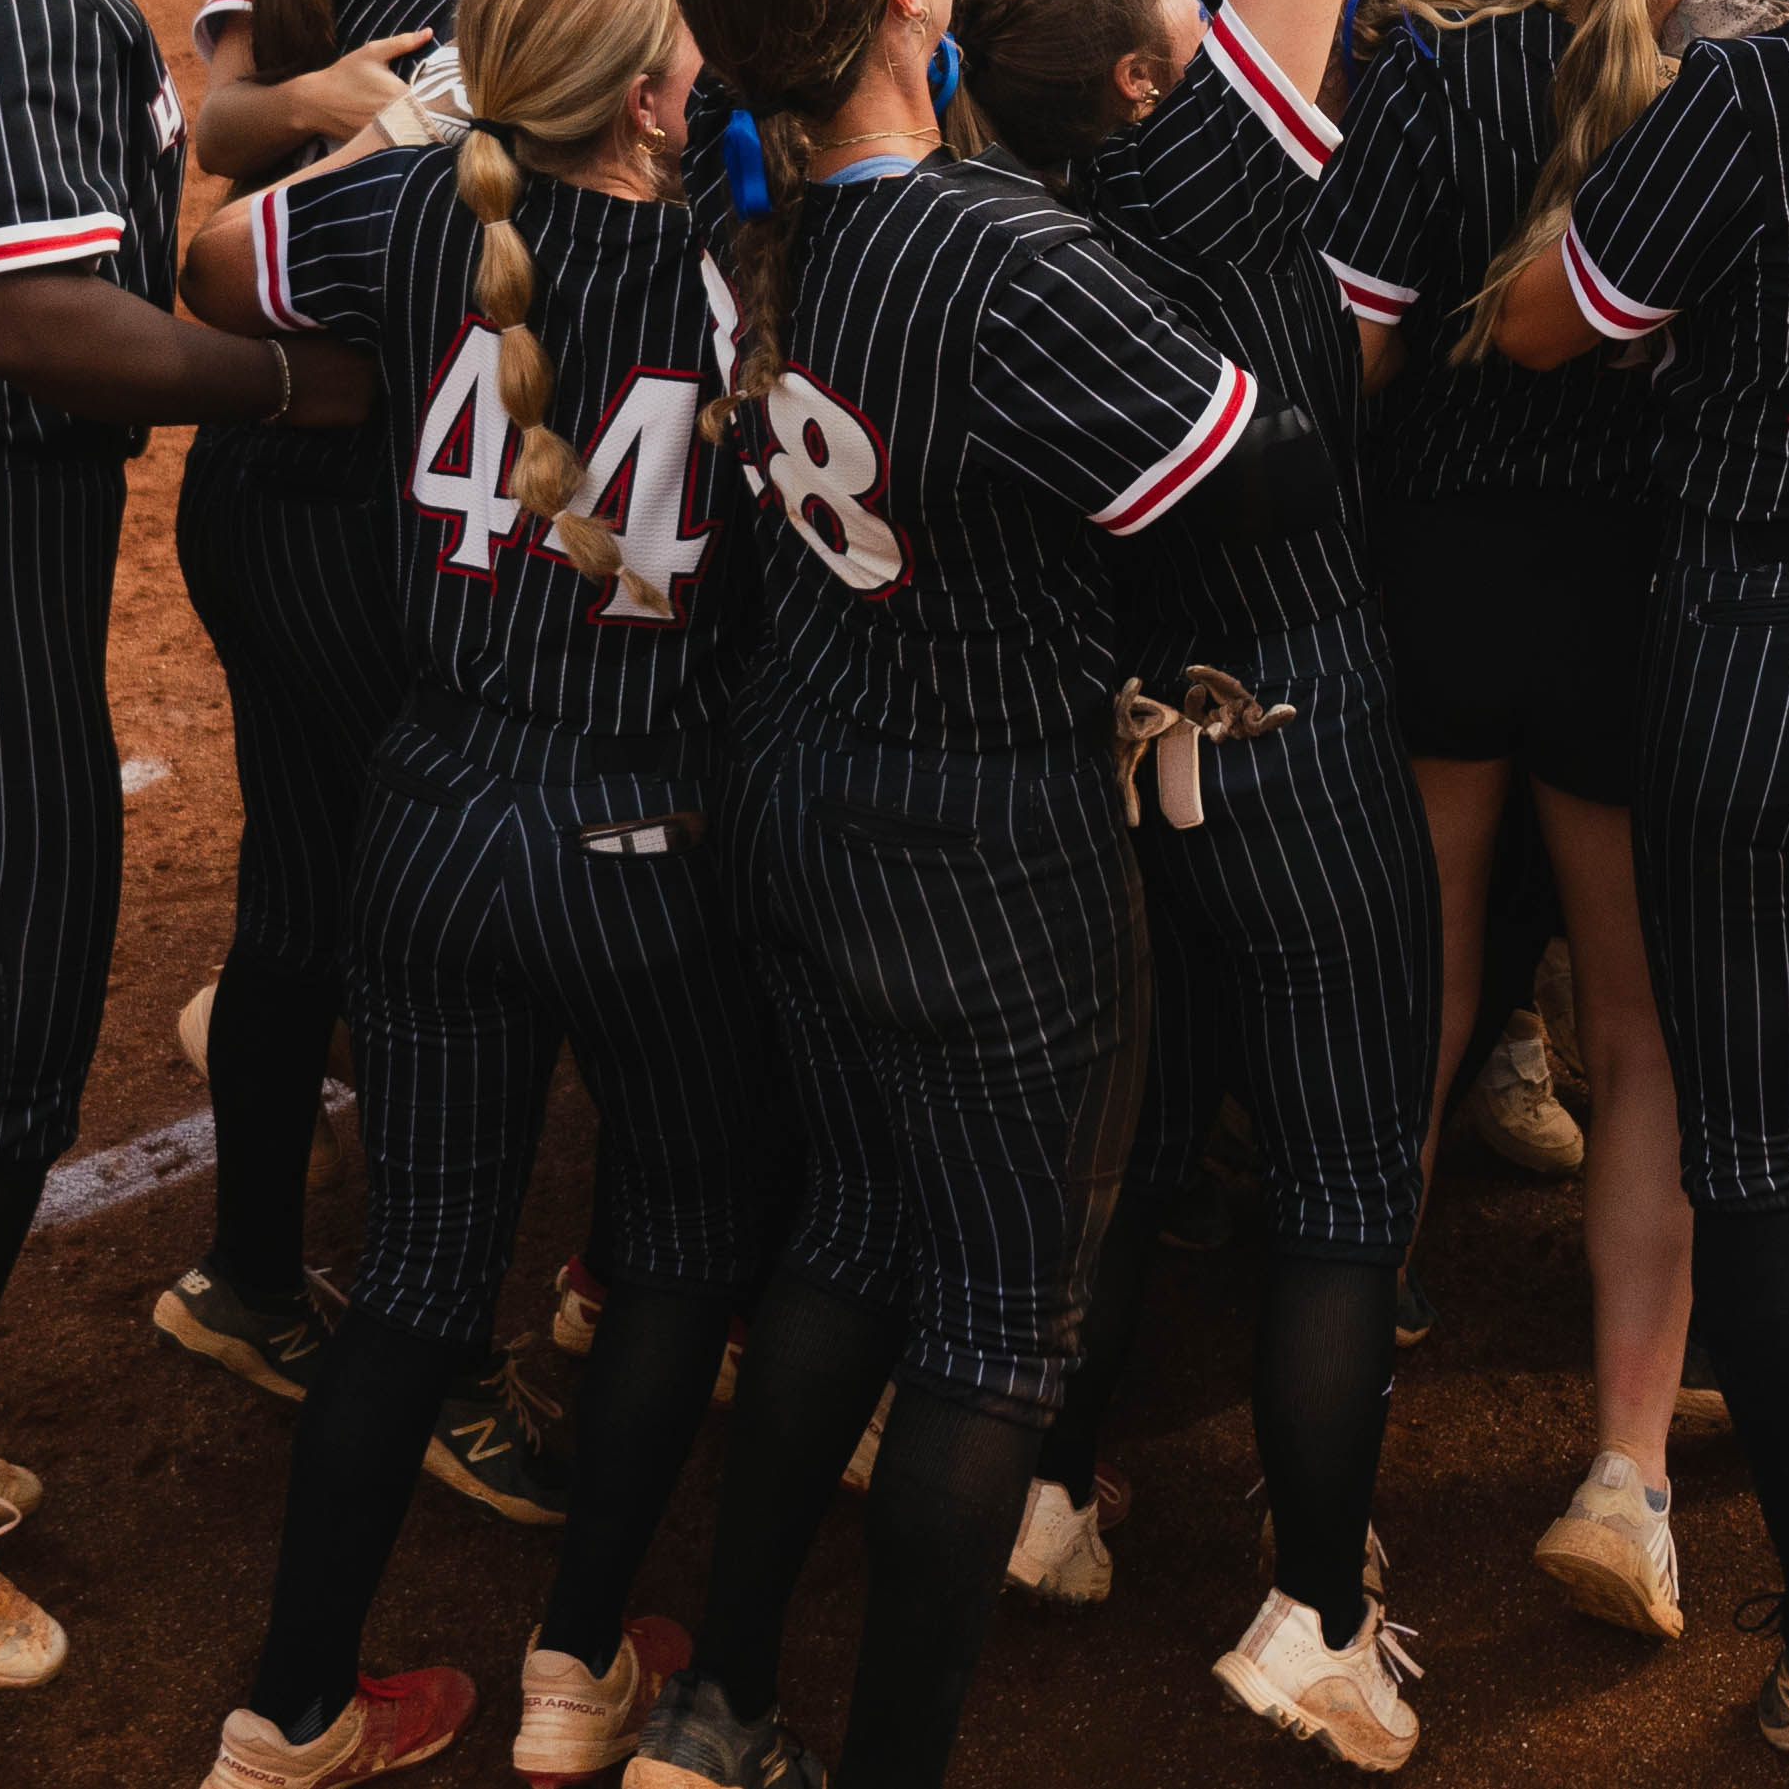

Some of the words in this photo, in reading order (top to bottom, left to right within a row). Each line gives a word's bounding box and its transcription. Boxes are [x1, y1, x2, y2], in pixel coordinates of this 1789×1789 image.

[406, 315, 719, 628] 44
[545, 1697, 606, 1717] ARMOUR
[221, 1755, 287, 1787] ARMOUR
